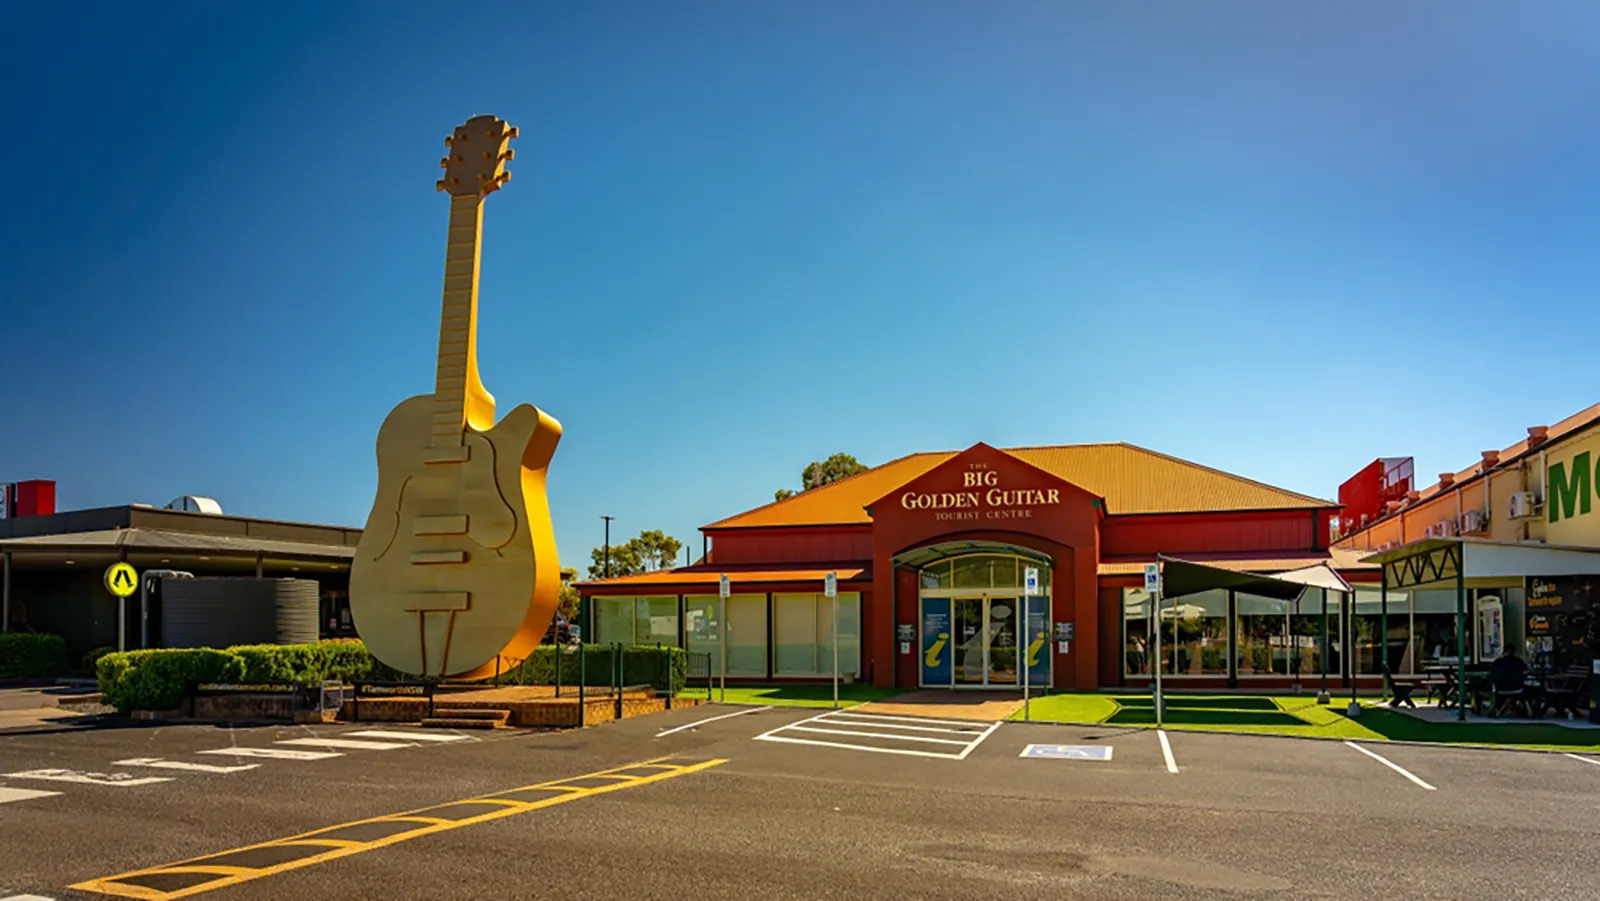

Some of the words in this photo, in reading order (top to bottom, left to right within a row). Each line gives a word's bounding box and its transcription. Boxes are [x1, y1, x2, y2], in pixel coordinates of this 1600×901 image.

[963, 471, 998, 487] BIG
[1549, 451, 1600, 523] M
[901, 492, 980, 510] GOLDEN
[986, 488, 1060, 506] GUITAR
[935, 511, 980, 520] TOURIST
[986, 509, 1032, 519] CENTRE
